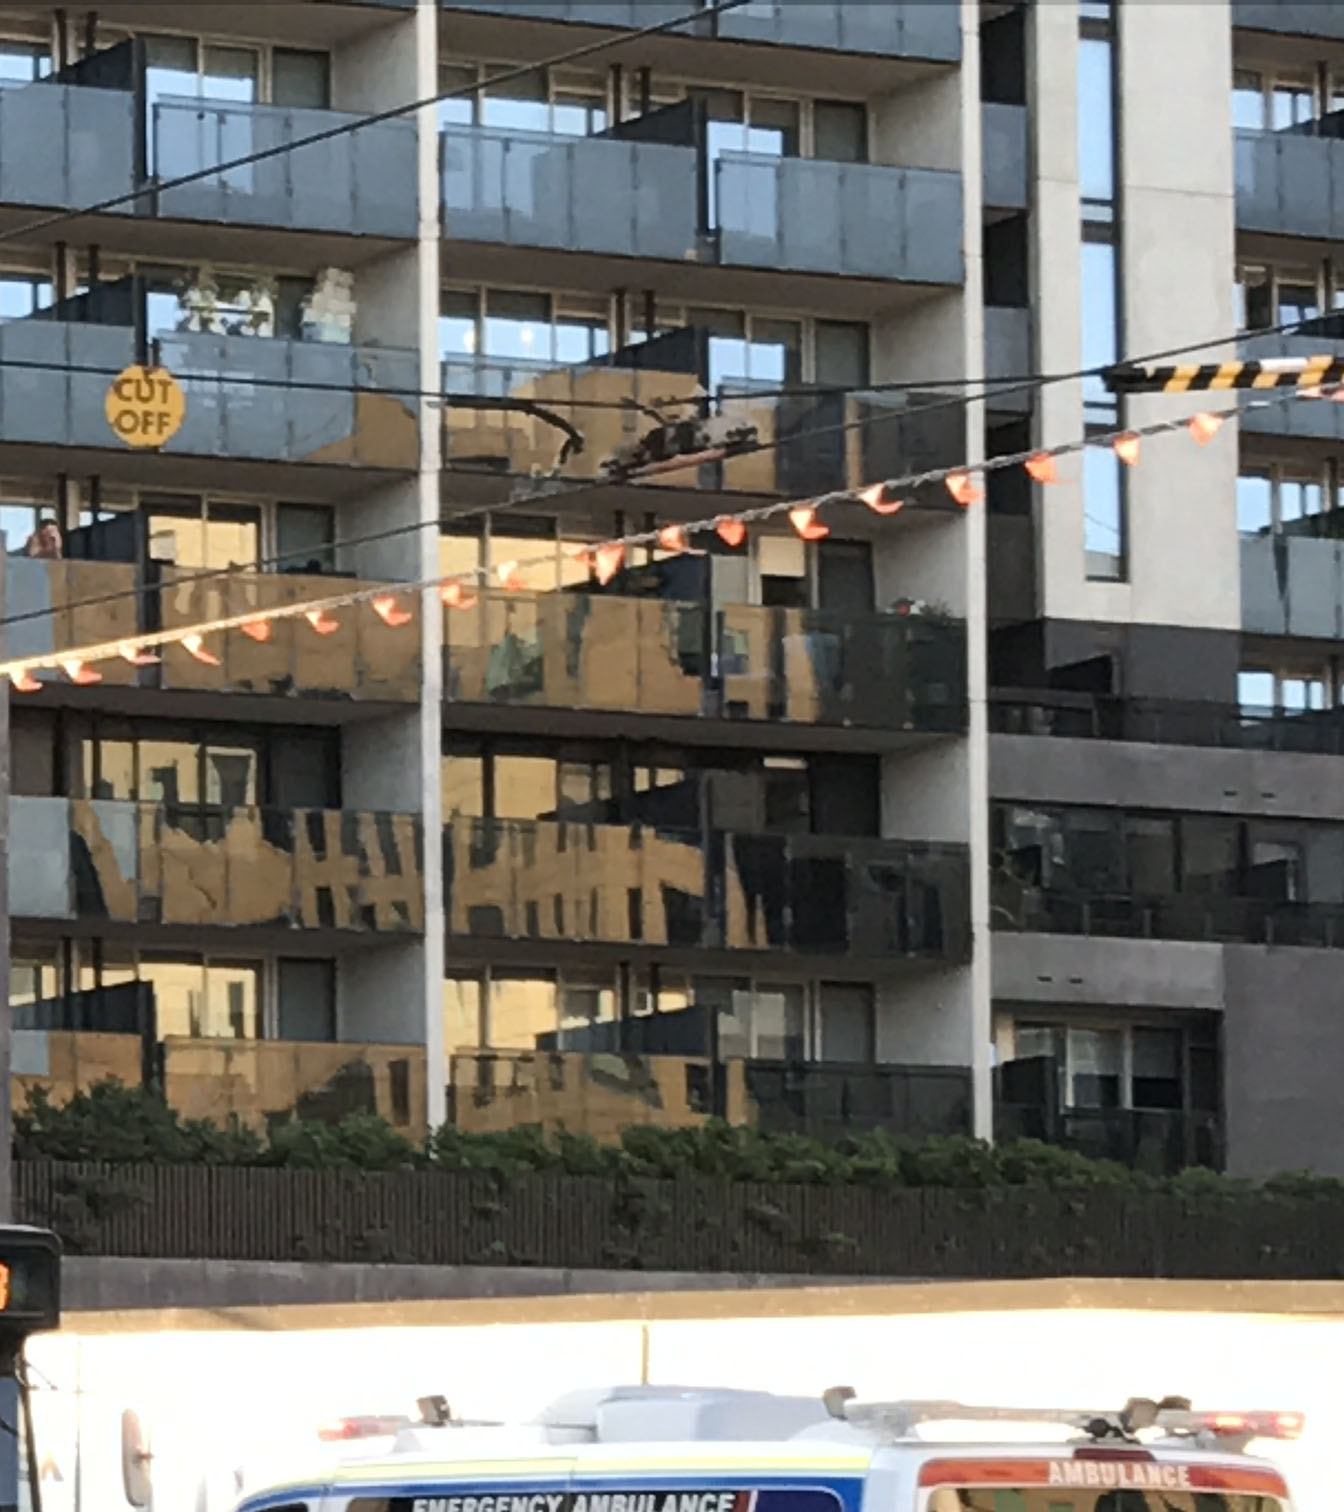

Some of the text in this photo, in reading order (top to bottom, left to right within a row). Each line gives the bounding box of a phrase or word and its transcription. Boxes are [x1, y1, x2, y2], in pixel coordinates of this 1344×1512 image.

[113, 377, 173, 404] CUT
[115, 409, 171, 435] OFF
[1048, 1461, 1191, 1488] AMBULANCE
